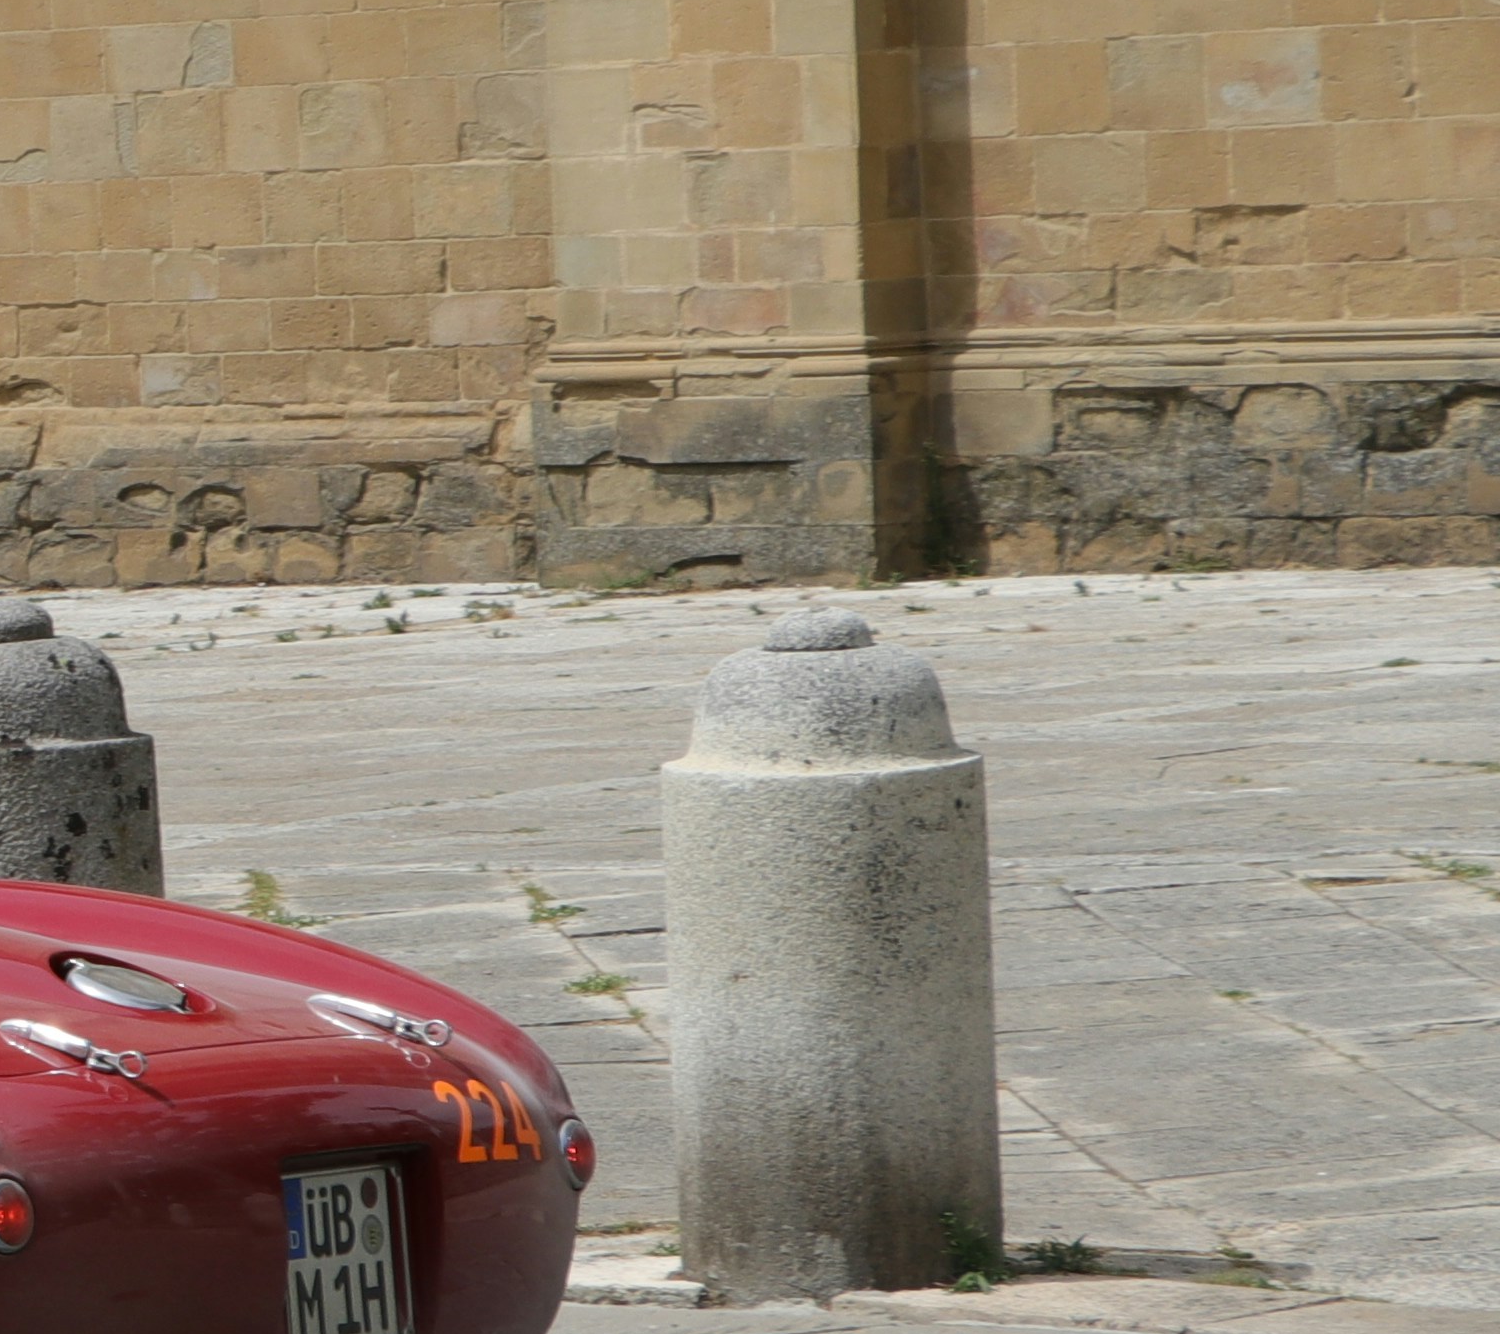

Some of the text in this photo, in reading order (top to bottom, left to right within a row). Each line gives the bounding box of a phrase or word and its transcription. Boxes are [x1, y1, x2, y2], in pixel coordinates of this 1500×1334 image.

[433, 1079, 542, 1163] 224
[289, 1230, 300, 1250] D
[306, 1184, 356, 1258] ÜB
